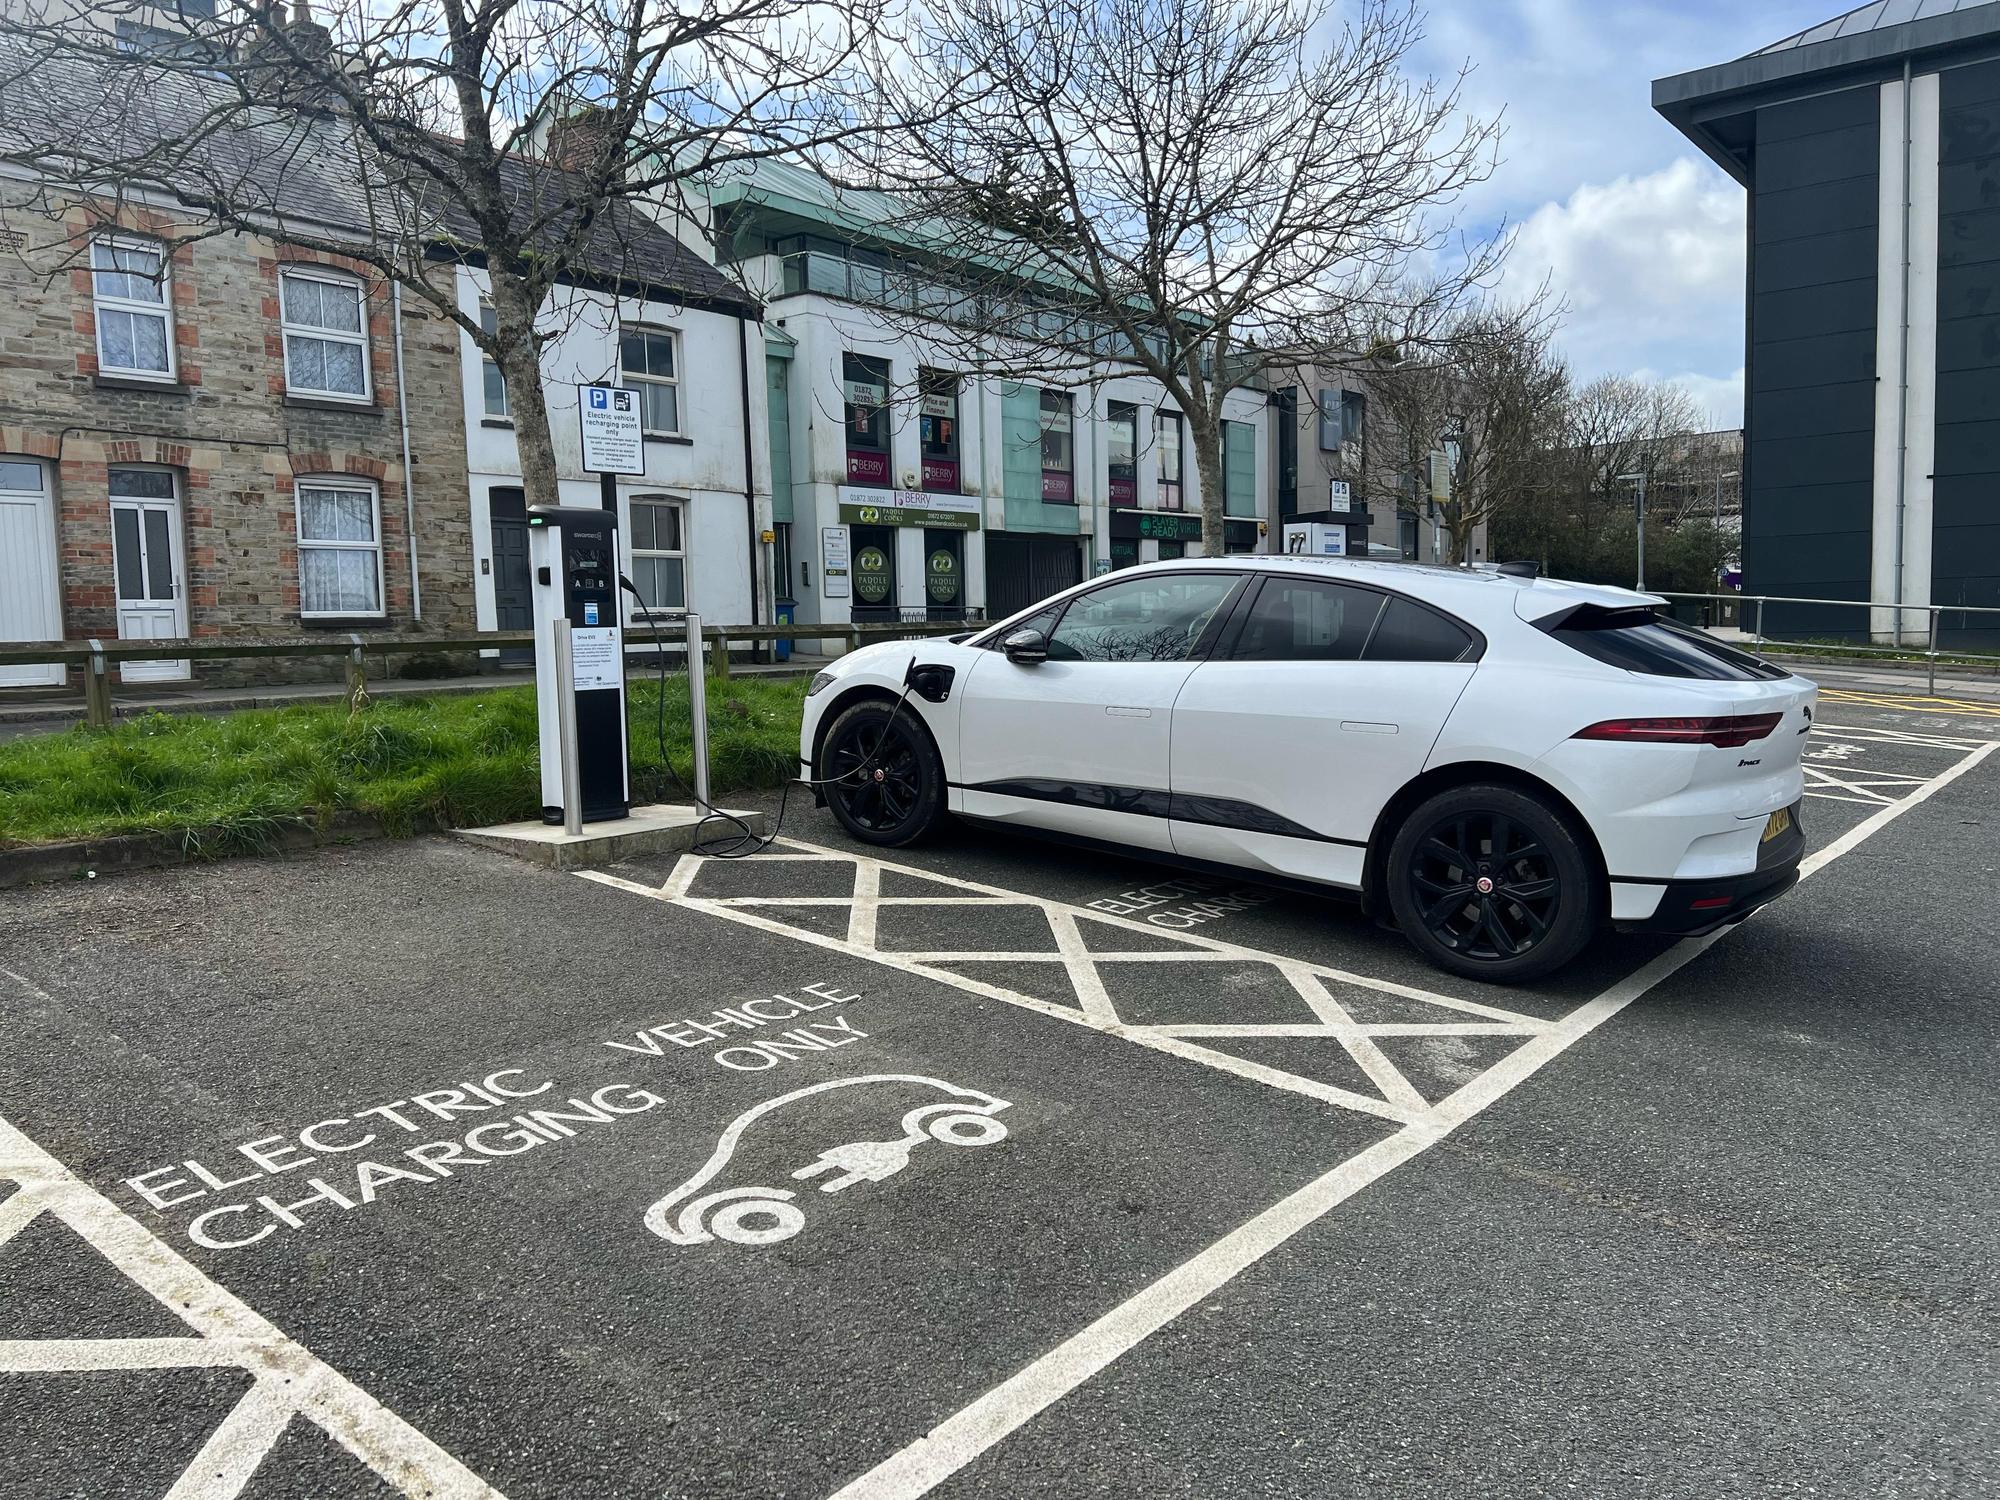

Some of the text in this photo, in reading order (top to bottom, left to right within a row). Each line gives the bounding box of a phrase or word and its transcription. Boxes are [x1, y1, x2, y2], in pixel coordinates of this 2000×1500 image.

[854, 385, 872, 395] 01872
[593, 391, 603, 406] P
[926, 405, 946, 415] Finance
[587, 411, 636, 422] Electric vehicle
[586, 420, 638, 430] recharging point
[605, 429, 620, 437] only
[858, 459, 884, 475] BERRY
[931, 466, 954, 482] BERRY
[1049, 479, 1068, 492] BERRY
[1114, 485, 1132, 498] BERRY
[905, 492, 931, 508] BERRY
[1152, 516, 1178, 527] PLAYER
[1152, 521, 1201, 539] READY VIRTU
[575, 579, 605, 588] A B
[858, 576, 887, 584] PADDLE
[930, 577, 956, 585] PADDLE
[860, 585, 886, 593] COCKS
[931, 586, 955, 594] COCKS
[120, 981, 864, 1212] ELECTRIC VEHICLE
[187, 1015, 869, 1250] CHARGING ONLY
